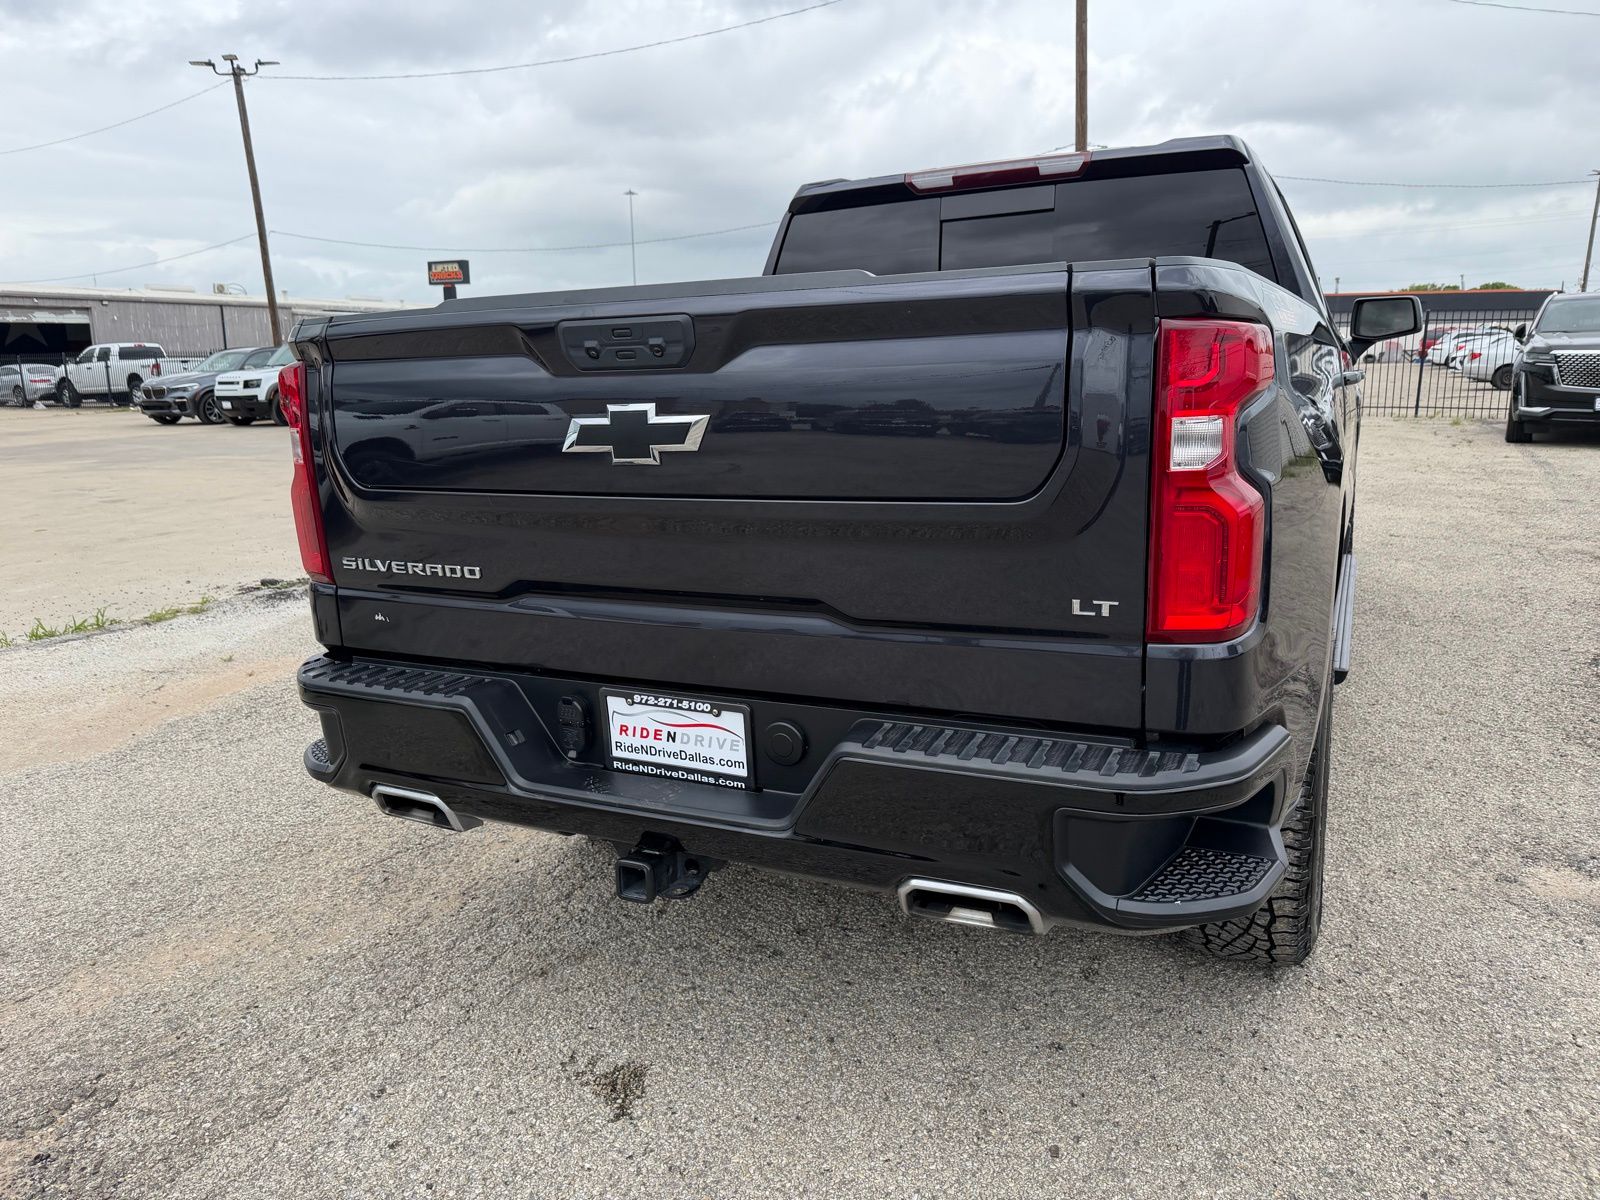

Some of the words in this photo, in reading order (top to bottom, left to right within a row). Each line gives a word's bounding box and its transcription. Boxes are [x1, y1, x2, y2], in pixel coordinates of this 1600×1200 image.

[342, 557, 482, 579] SILVERADO
[1072, 599, 1119, 617] LT
[633, 694, 711, 712] 972-271-5100
[615, 741, 745, 770] RideNDriveDallas.com
[613, 761, 746, 789] RideNDriveDallas.com
